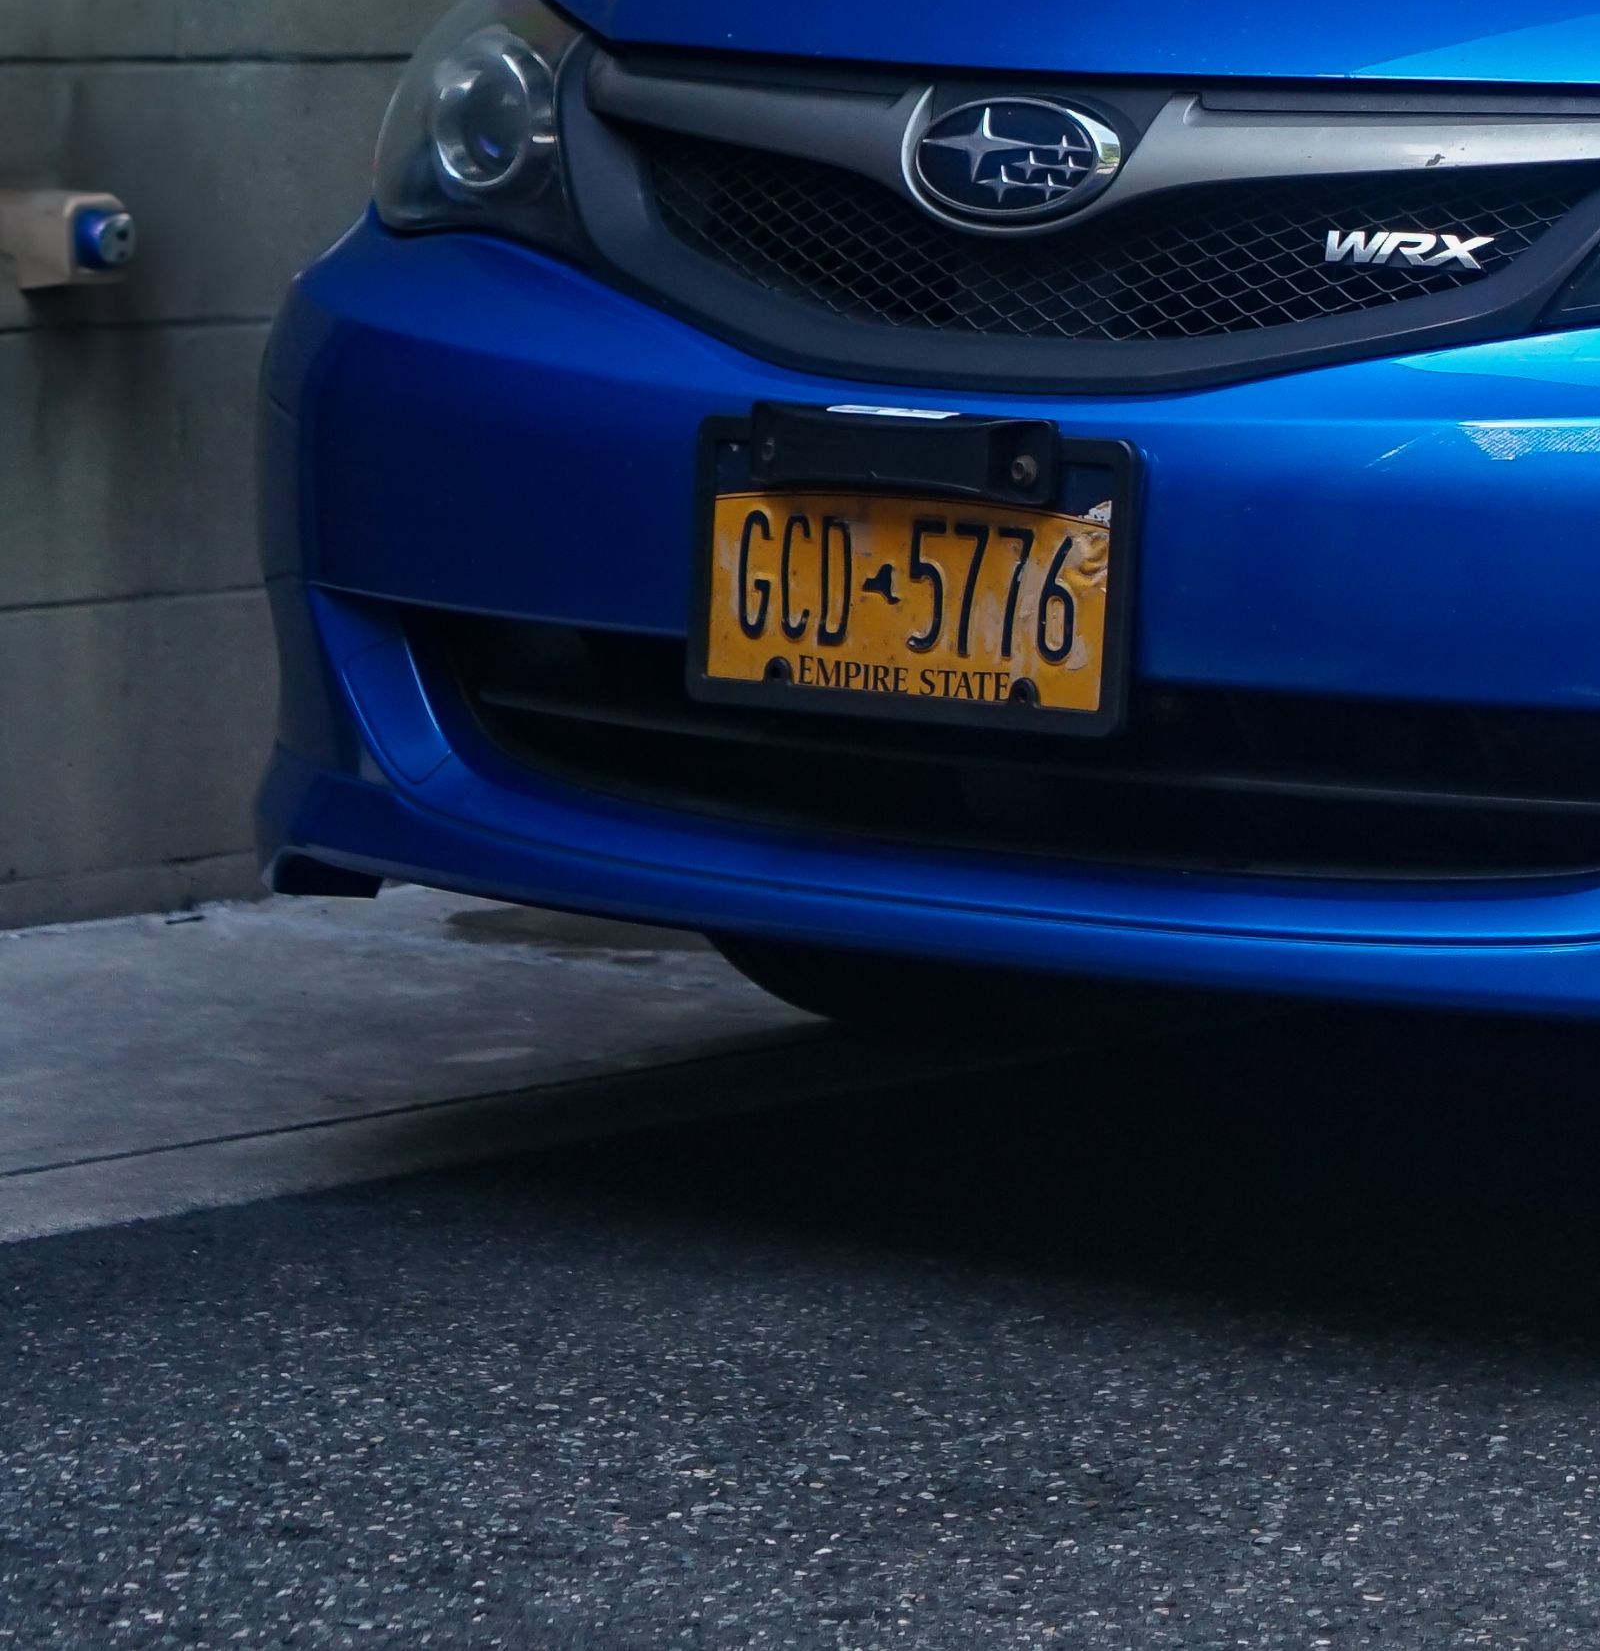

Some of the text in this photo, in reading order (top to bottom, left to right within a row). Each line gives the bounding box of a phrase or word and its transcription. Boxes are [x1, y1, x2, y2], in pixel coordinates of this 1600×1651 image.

[1324, 229, 1495, 270] WRX
[739, 509, 1074, 665] GCD 5776
[798, 654, 1010, 702] EMPIRE STATE
